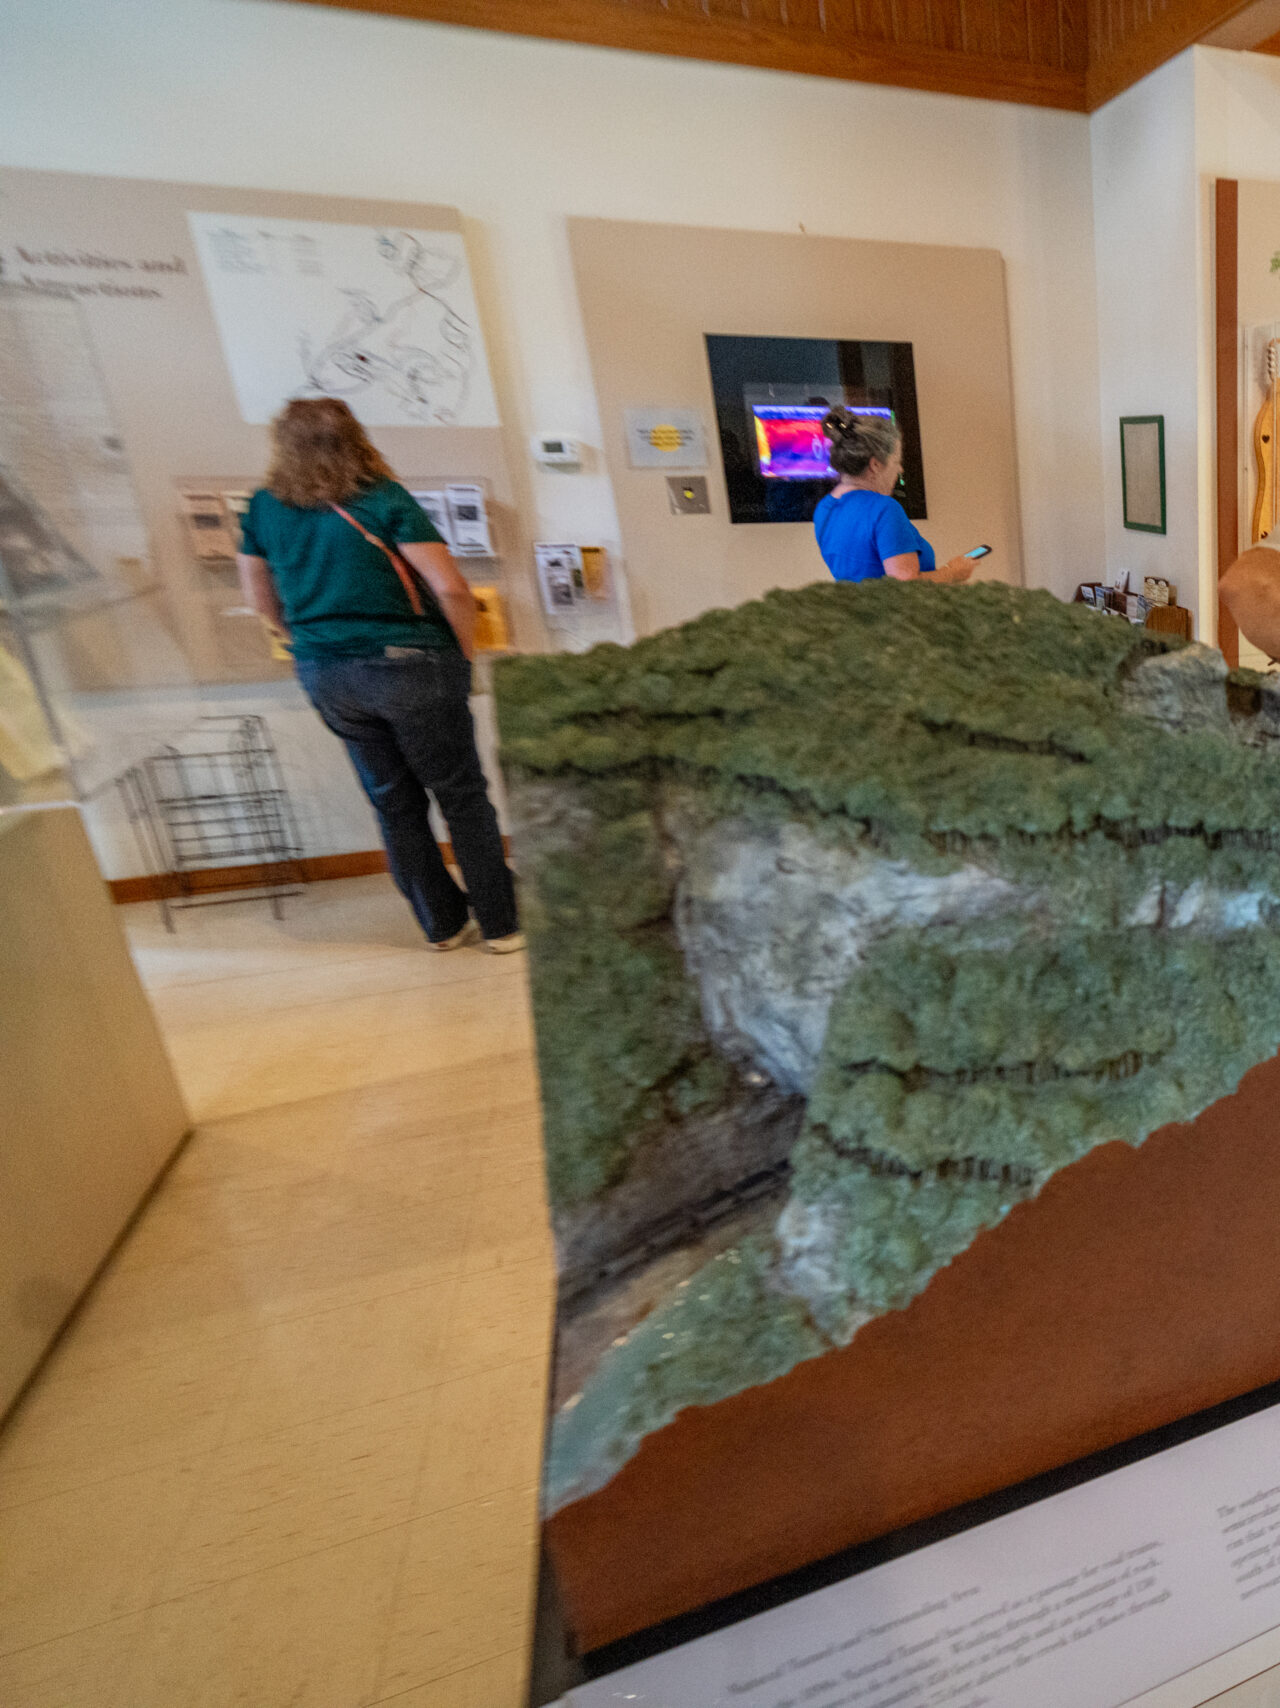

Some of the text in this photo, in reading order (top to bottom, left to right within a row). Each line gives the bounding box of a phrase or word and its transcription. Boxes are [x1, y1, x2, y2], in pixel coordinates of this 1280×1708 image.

[1216, 1505, 1236, 1518] The
[1238, 1486, 1280, 1508] southern
[1245, 1527, 1264, 1541] that
[1230, 1544, 1270, 1567] opening
[1272, 1534, 1280, 1547] of
[1265, 1555, 1275, 1569] of
